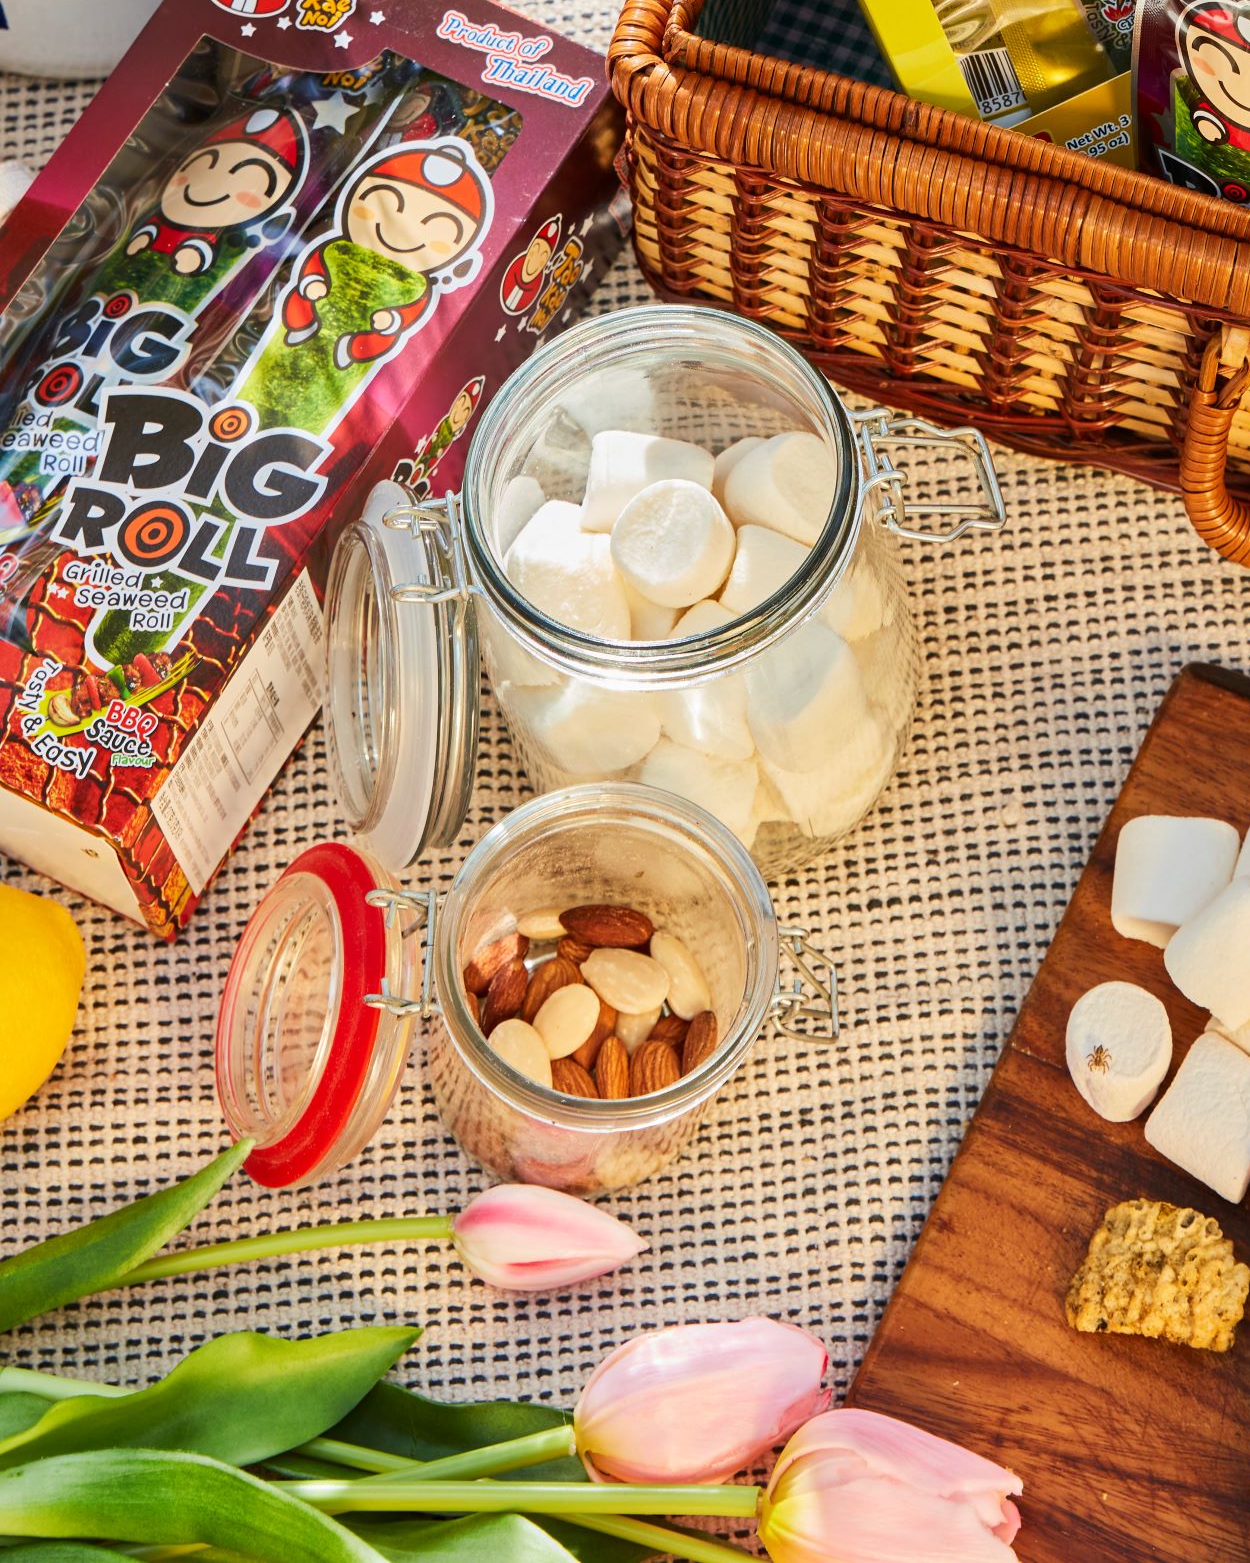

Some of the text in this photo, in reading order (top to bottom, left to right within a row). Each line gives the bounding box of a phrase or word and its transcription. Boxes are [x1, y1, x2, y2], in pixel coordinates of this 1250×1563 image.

[301, 11, 342, 30] Noi
[444, 15, 548, 60] Product of
[485, 58, 589, 101] Thailand
[1066, 134, 1093, 150] Net
[1092, 123, 1119, 138] Wt.
[1108, 132, 1129, 149] oz)
[2, 430, 100, 452] eaweed
[43, 454, 83, 472] Roll
[59, 487, 269, 583] ROLL
[65, 562, 142, 587] Grilled
[77, 588, 186, 609] Seaweed
[133, 610, 171, 629] Roll
[18, 660, 95, 776] Tasty & Easy
[107, 702, 157, 738] BBQ
[86, 719, 151, 757] Sauce
[111, 753, 156, 767] Flavour
